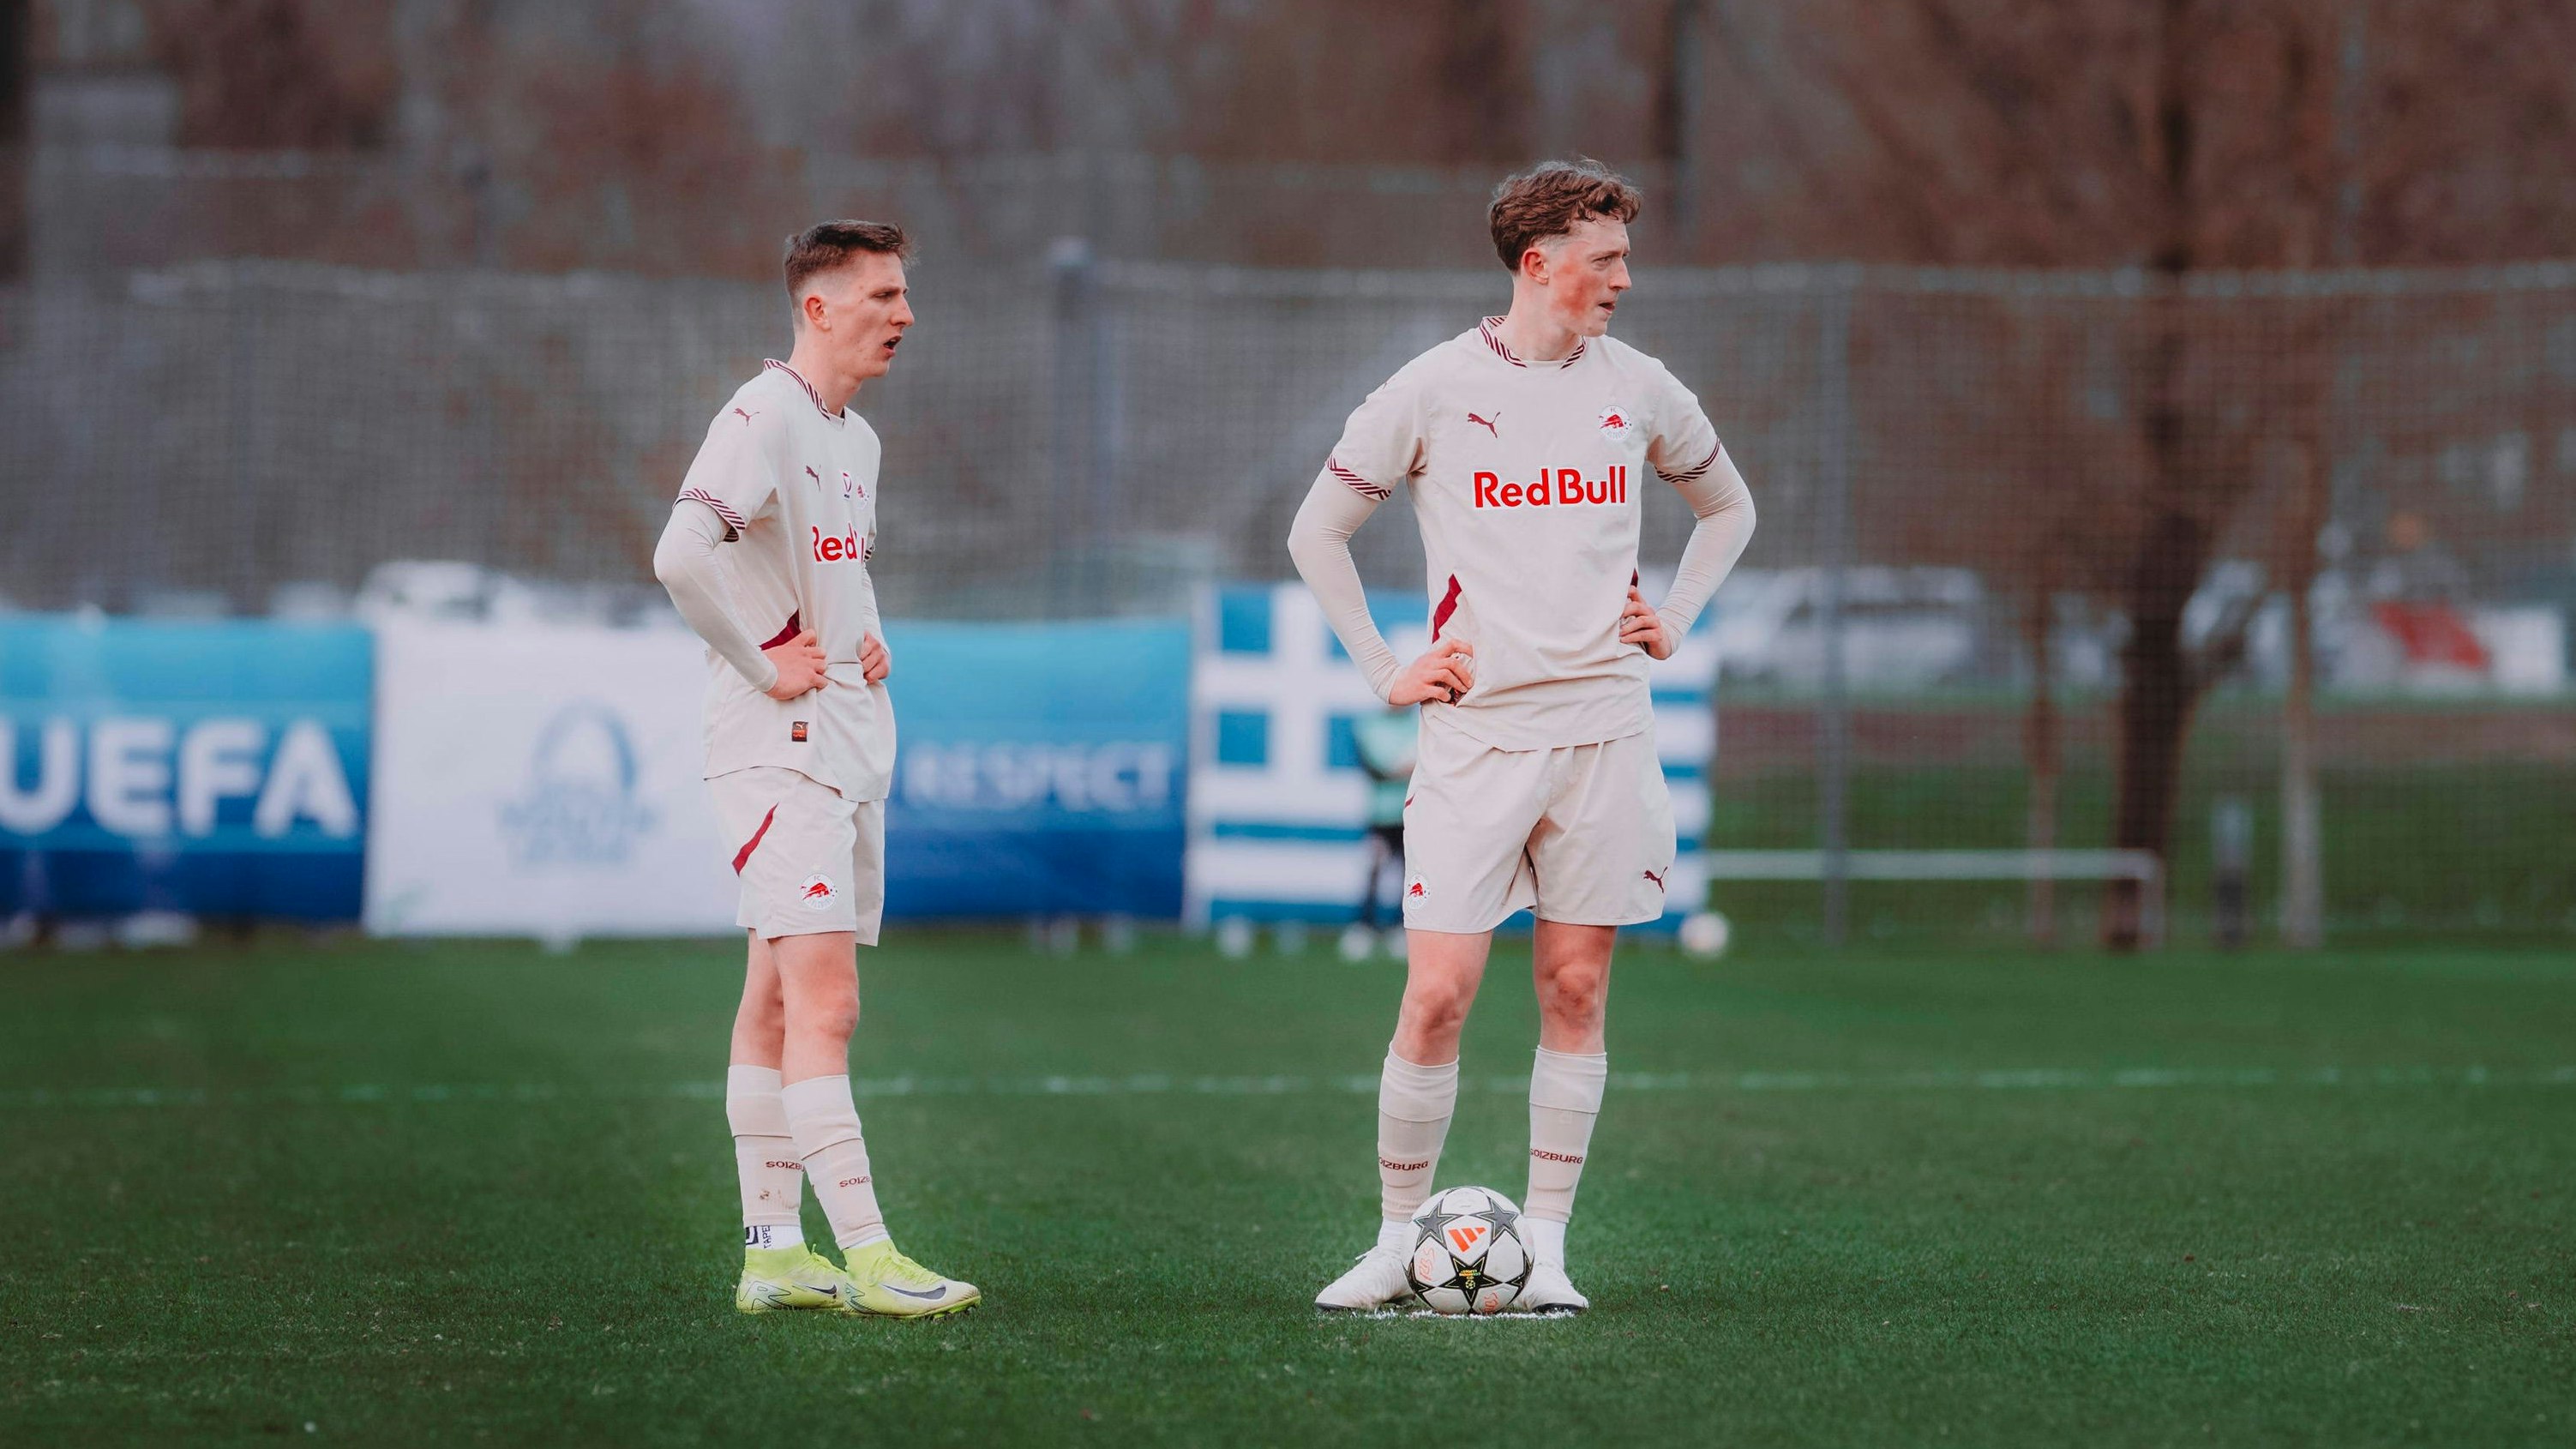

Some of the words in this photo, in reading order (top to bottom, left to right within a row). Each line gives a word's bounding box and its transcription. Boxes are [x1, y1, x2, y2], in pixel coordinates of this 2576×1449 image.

[1474, 468, 1551, 508] Red
[1557, 466, 1626, 504] Bull
[0, 716, 360, 839] UEFA
